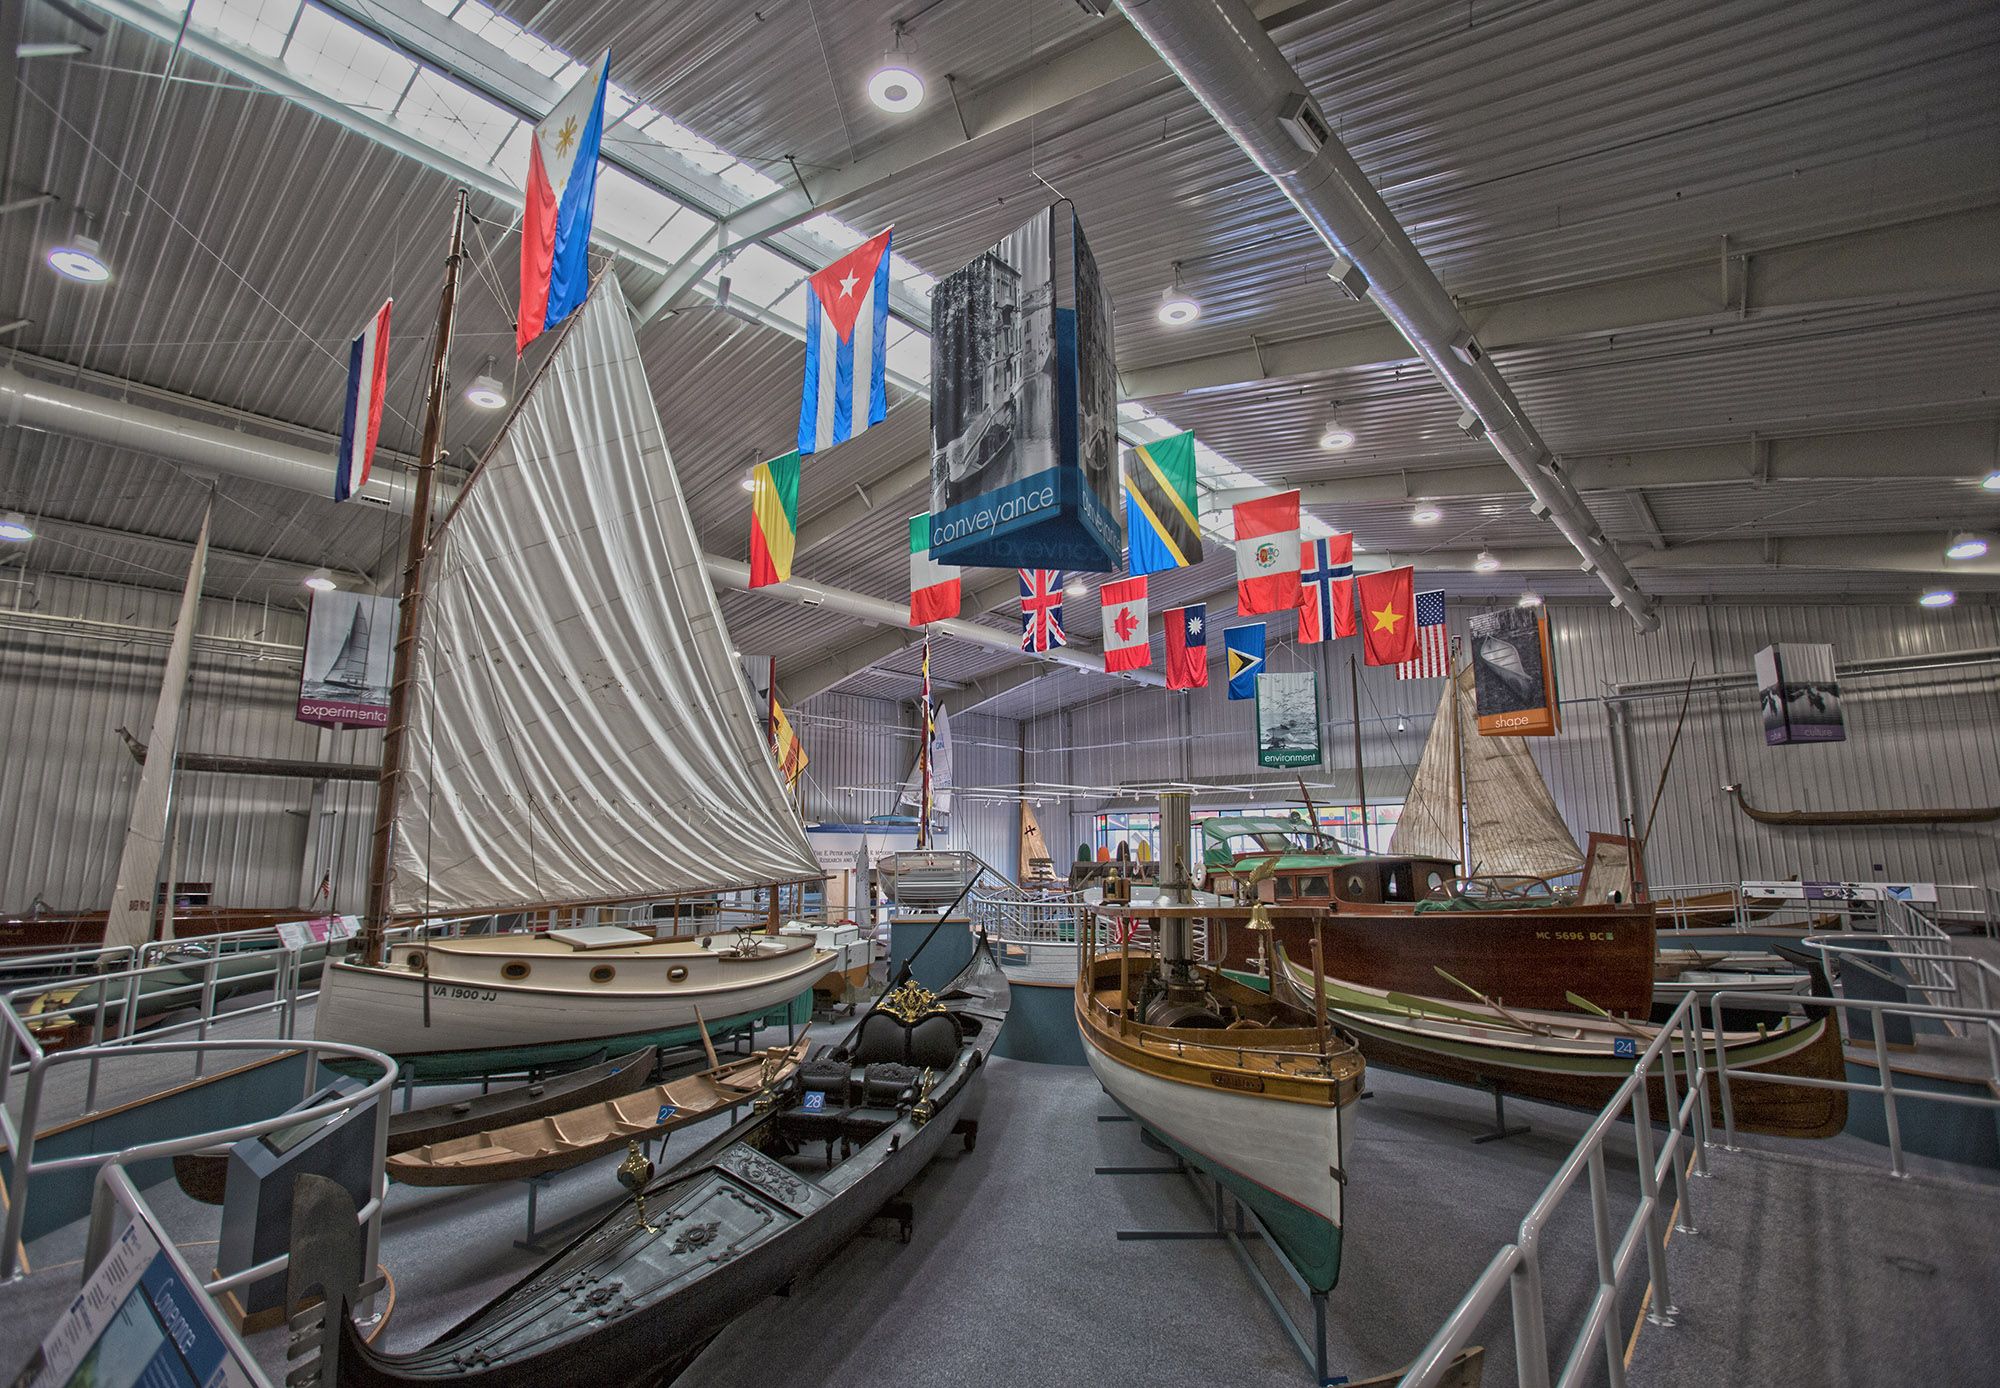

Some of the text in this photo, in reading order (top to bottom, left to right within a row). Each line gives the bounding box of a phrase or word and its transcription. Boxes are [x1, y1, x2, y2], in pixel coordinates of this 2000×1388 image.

[933, 487, 1054, 546] conveyance
[301, 705, 387, 721] experimenta
[1495, 714, 1529, 730] shape
[1804, 727, 1832, 737] culture
[1264, 753, 1316, 763] environment
[1536, 932, 1604, 940] MC 5696 BC
[433, 986, 497, 1001] VA 1900 JJ
[1616, 1041, 1633, 1053] 24
[806, 1095, 821, 1108] 28
[659, 1109, 675, 1121] 27
